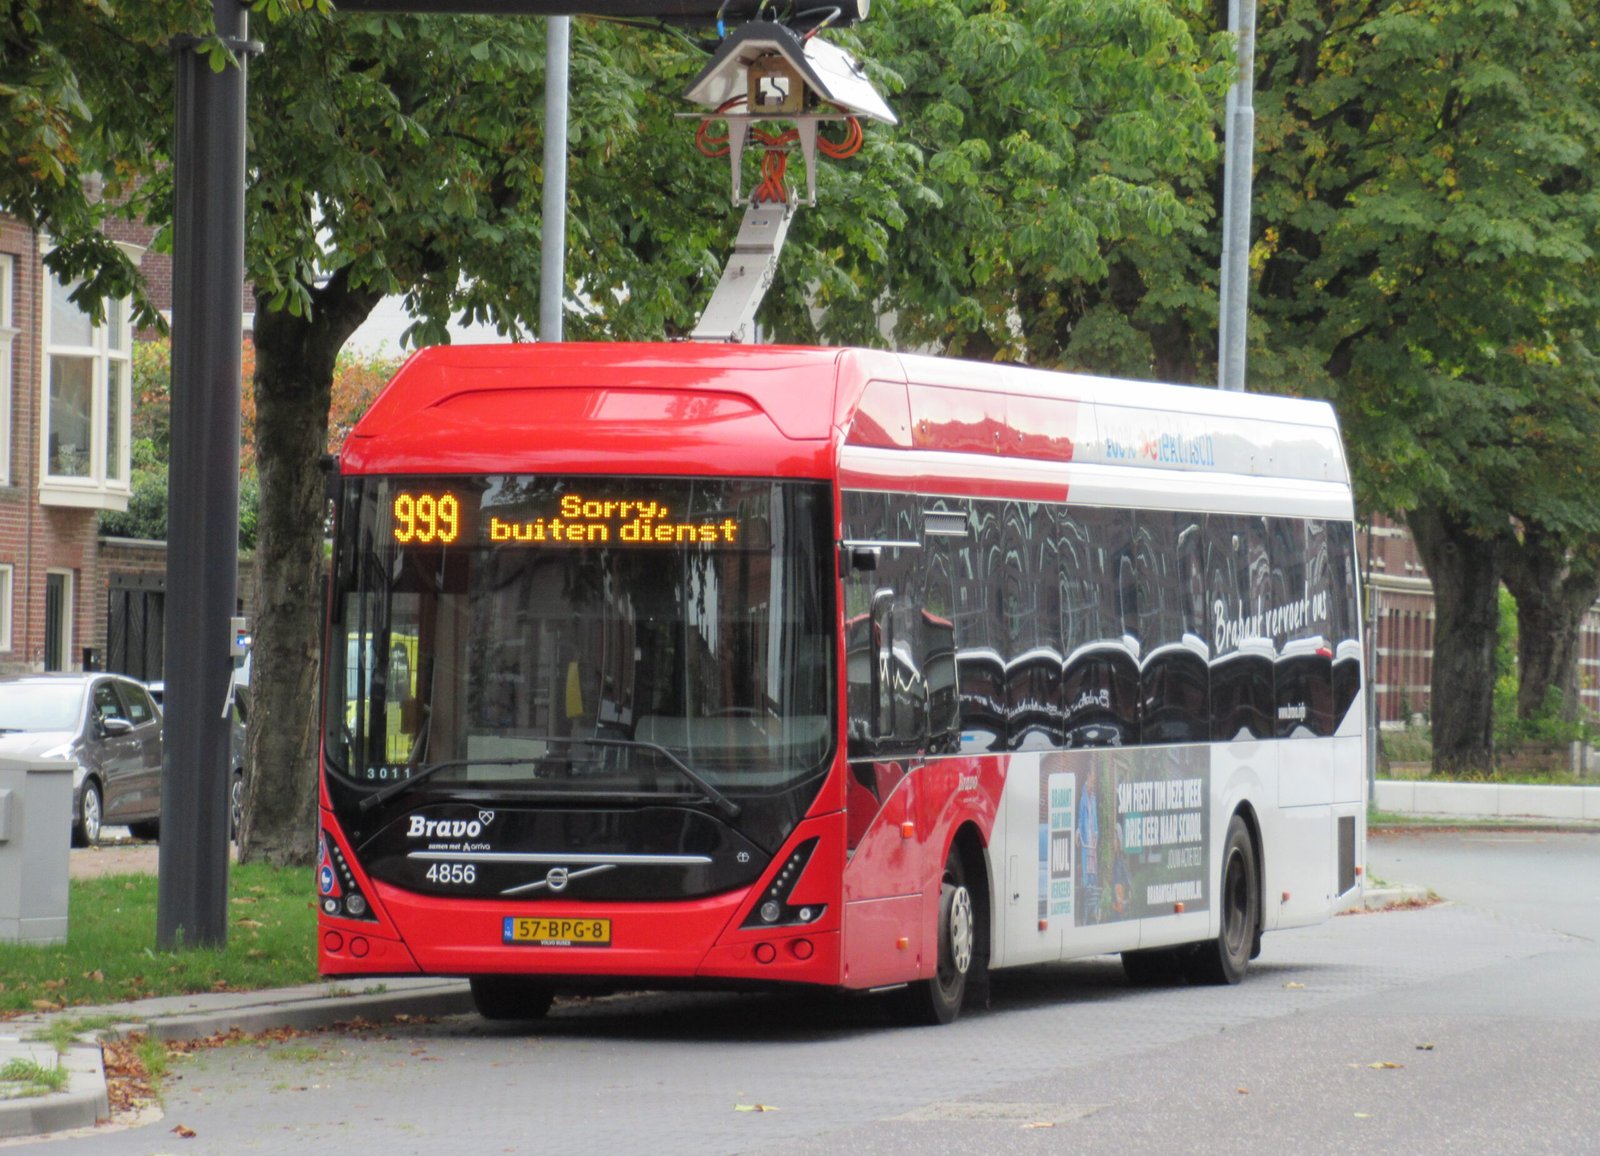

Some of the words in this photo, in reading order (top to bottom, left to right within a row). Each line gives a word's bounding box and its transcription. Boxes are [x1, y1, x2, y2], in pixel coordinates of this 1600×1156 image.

[394, 494, 459, 542] 999
[561, 495, 668, 518] Sorry,
[490, 518, 608, 541] buiten
[619, 519, 738, 542] dienst
[1214, 594, 1263, 654] Brabant
[1265, 577, 1310, 637] vervoert
[1312, 589, 1327, 622] ons
[367, 767, 412, 779] 3011
[1166, 780, 1183, 810] DEZE
[1183, 778, 1202, 808] WEEK
[406, 815, 481, 837] Bravo
[1125, 818, 1141, 848] DRIE
[1142, 816, 1159, 846] KEER
[1160, 814, 1178, 845] NAAR
[1179, 812, 1202, 843] SCHOOL
[1052, 838, 1070, 873] NUL
[426, 863, 476, 883] 4856
[519, 921, 603, 938] 57-BPG-8
